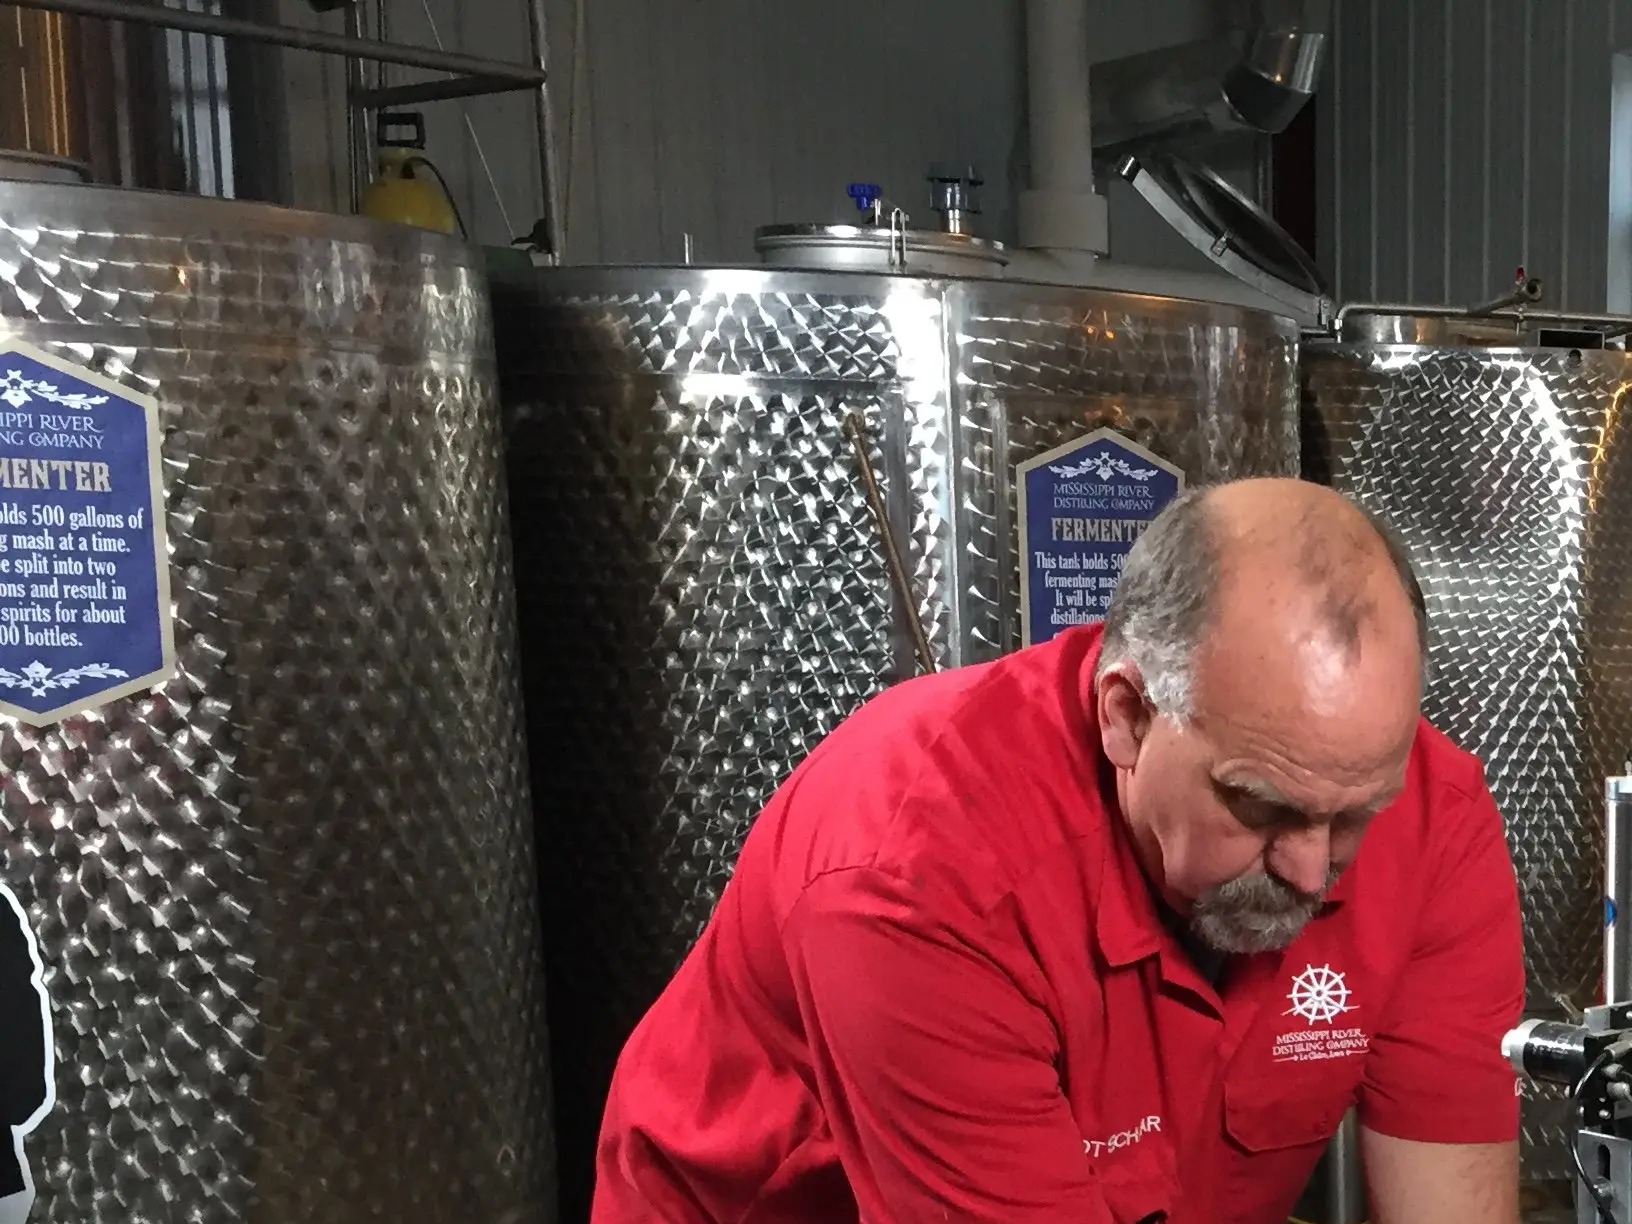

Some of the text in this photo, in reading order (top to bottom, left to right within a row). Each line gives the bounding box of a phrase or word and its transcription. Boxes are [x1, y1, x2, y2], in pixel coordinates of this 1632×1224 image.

[40, 414, 104, 433] RIVER
[28, 432, 104, 450] COMPANY
[1054, 482, 1155, 498] MISSISSIPPI RIVER
[1054, 497, 1155, 511] DISTILLING COMPANY
[32, 504, 65, 526] 500
[69, 505, 124, 531] gallons
[128, 507, 144, 529] of
[1051, 517, 1154, 542] FERMENTE
[12, 528, 55, 550] mash
[58, 532, 74, 551] at
[78, 537, 88, 551] a
[92, 531, 130, 552] time.
[14, 552, 49, 578] split
[53, 554, 83, 575] into
[87, 557, 116, 576] two
[1035, 551, 1056, 568] This
[1058, 552, 1080, 569] tank
[1082, 552, 1108, 569] holds
[30, 577, 59, 598] and
[63, 578, 107, 600] result
[112, 579, 127, 600] in
[1044, 570, 1096, 590] fermenting
[1055, 589, 1064, 606] It
[1066, 589, 1083, 606] will
[1085, 589, 1097, 606] be
[1, 601, 126, 627] spirits for about
[25, 624, 83, 646] bottles.
[1276, 1028, 1366, 1045] MISSISSIPPI RIVER
[1272, 1038, 1370, 1056] DISTILLING COMPANY
[1108, 1115, 1161, 1153] SCHAR
